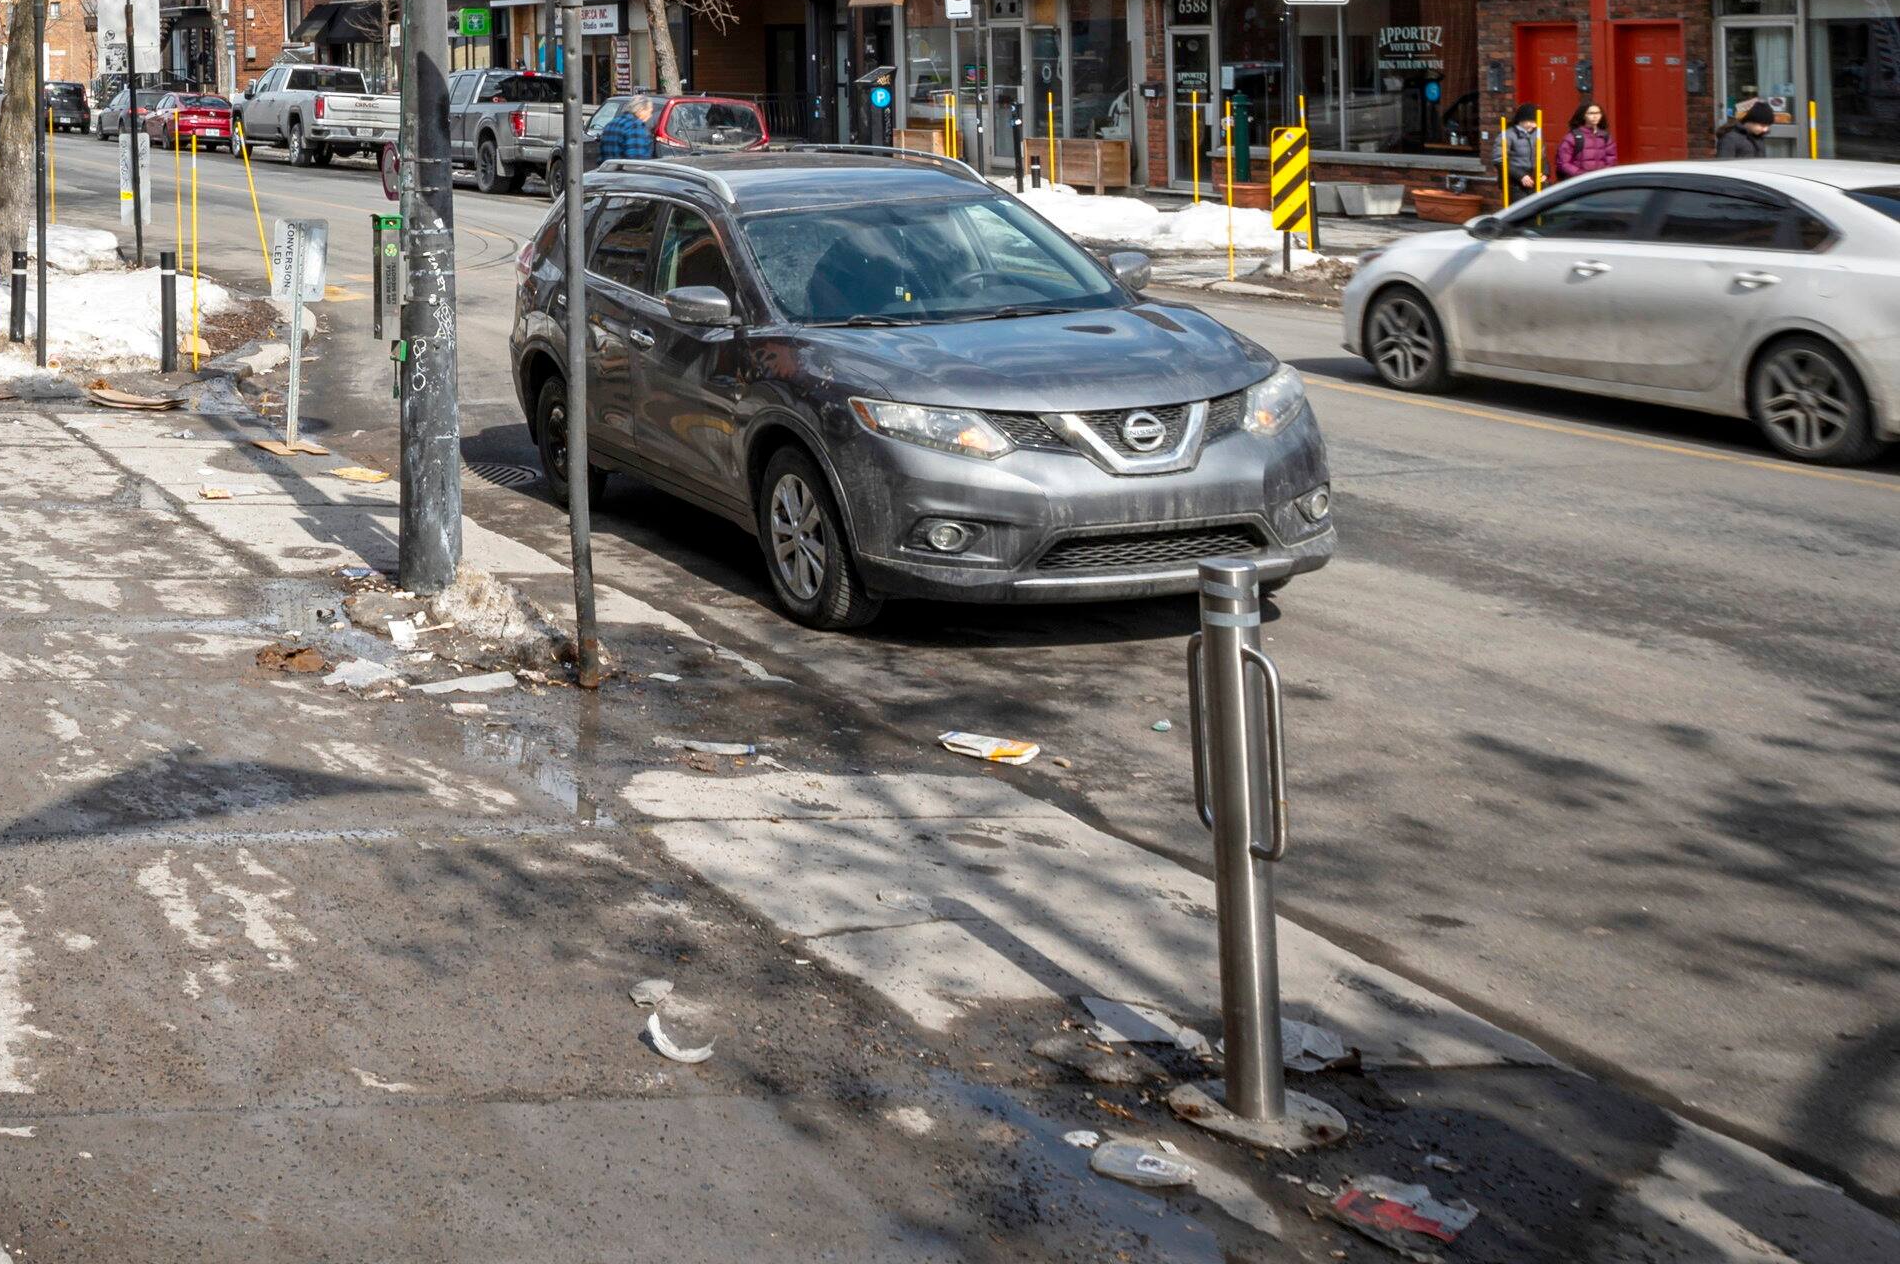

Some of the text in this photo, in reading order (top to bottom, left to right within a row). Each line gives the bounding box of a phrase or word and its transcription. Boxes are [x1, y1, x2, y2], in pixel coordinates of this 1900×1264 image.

[1379, 26, 1443, 48] APPORTEZ
[1390, 42, 1415, 52] VOTRE
[877, 91, 886, 103] P
[273, 245, 282, 265] LED
[284, 223, 295, 288] CONVERSION
[1129, 427, 1163, 436] NISSAN
